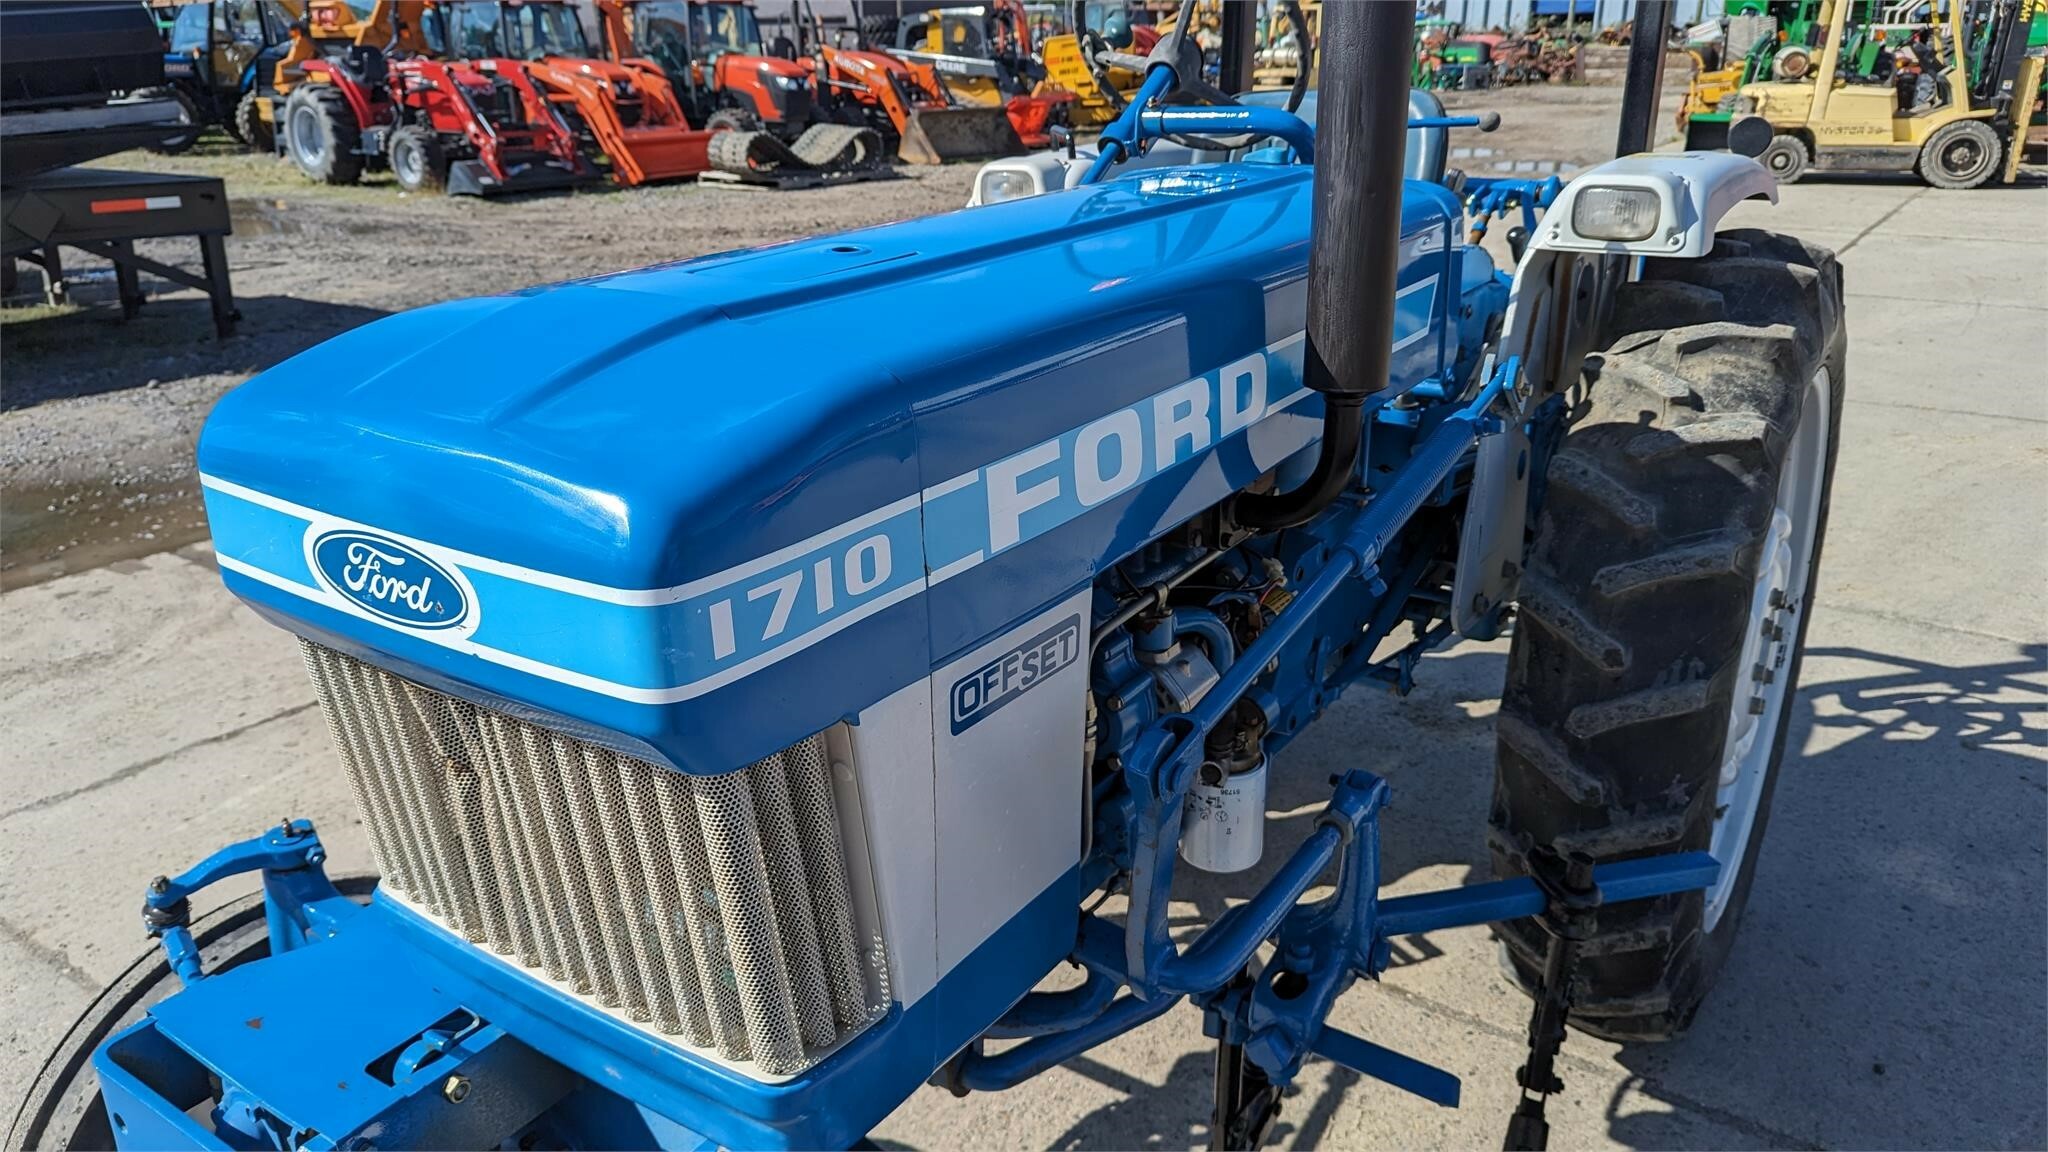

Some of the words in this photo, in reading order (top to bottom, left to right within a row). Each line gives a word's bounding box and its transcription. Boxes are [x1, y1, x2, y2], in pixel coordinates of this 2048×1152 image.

[986, 352, 1267, 554] FORD
[343, 542, 433, 613] Ford
[709, 534, 892, 661] 1710
[958, 629, 1074, 717] OFFSET
